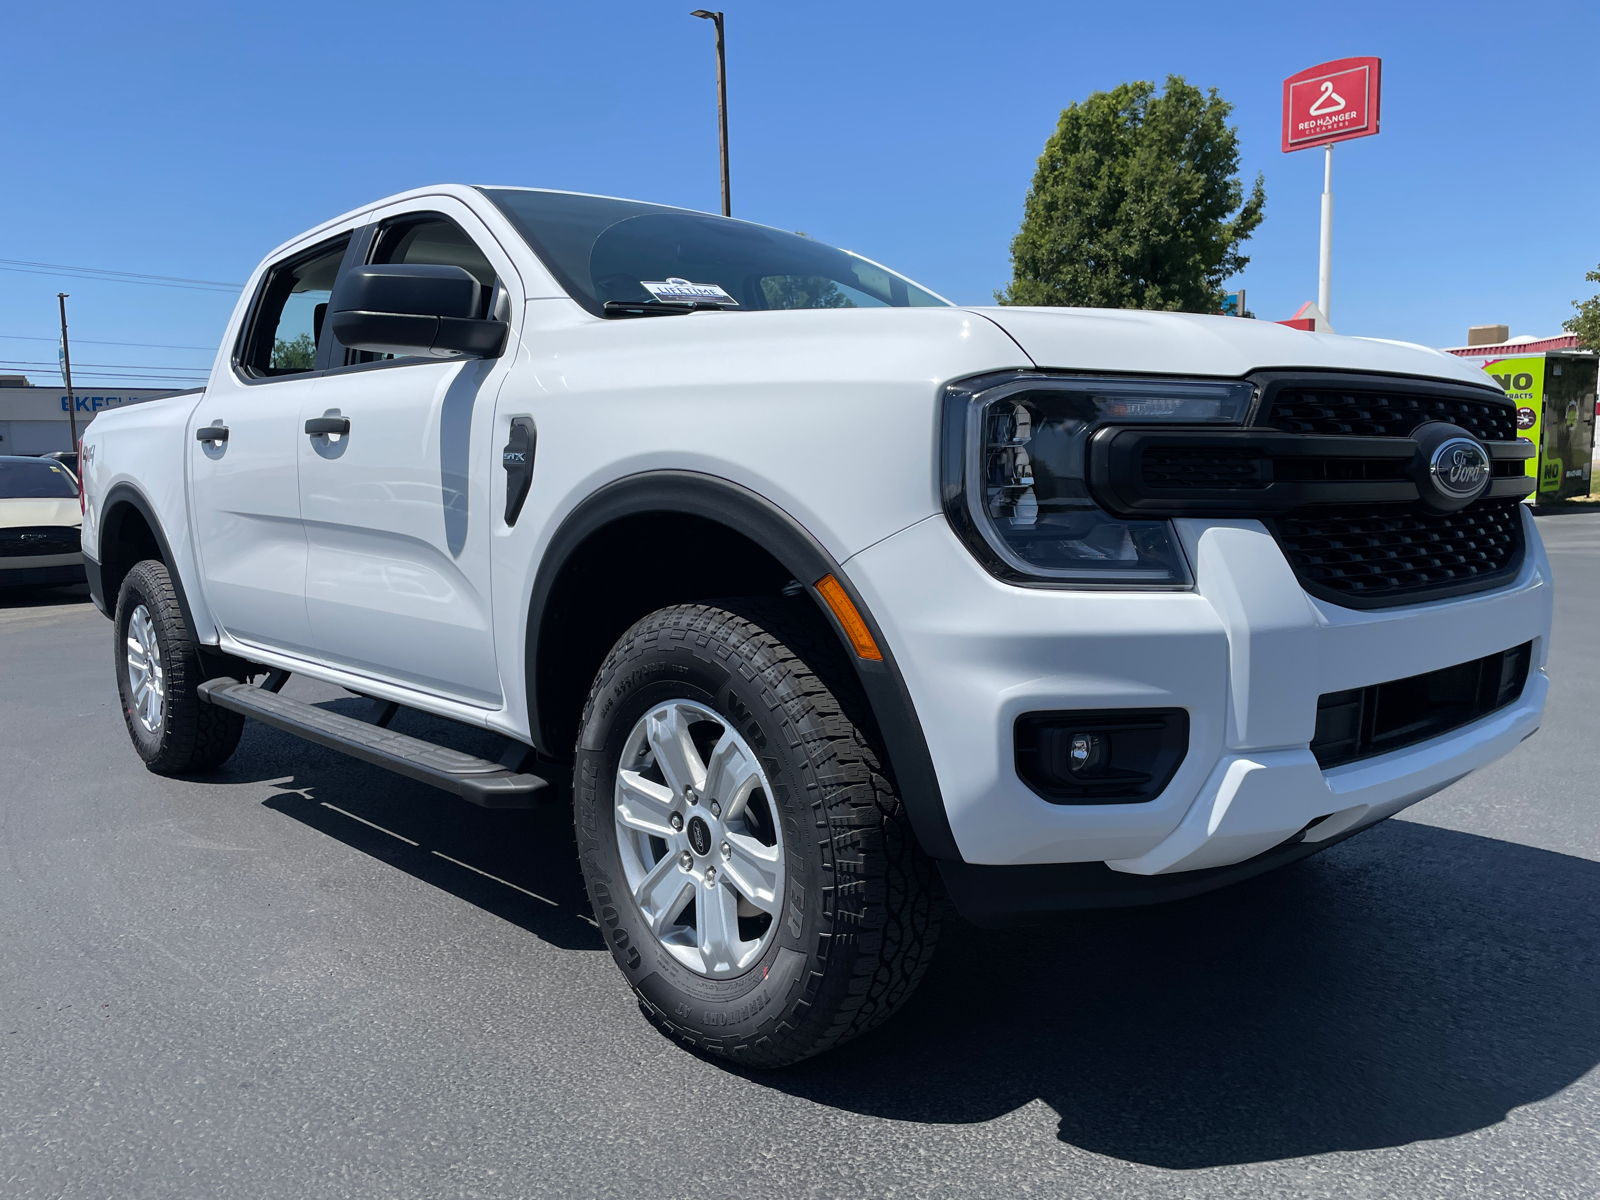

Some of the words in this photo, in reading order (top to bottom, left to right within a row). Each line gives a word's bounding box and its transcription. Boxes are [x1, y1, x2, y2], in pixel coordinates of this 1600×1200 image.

[1298, 120, 1316, 130] RED
[1306, 121, 1349, 134] CLEANERS
[657, 286, 720, 296] LIFETIME
[1492, 372, 1534, 391] NO
[503, 452, 526, 462] STX
[1450, 449, 1480, 483] Ford
[1544, 464, 1559, 479] NO
[728, 689, 805, 939] WRANGLER
[580, 758, 642, 971] GOODYEAR
[675, 1002, 692, 1019] AT
[701, 989, 772, 1027] TERRITORY
